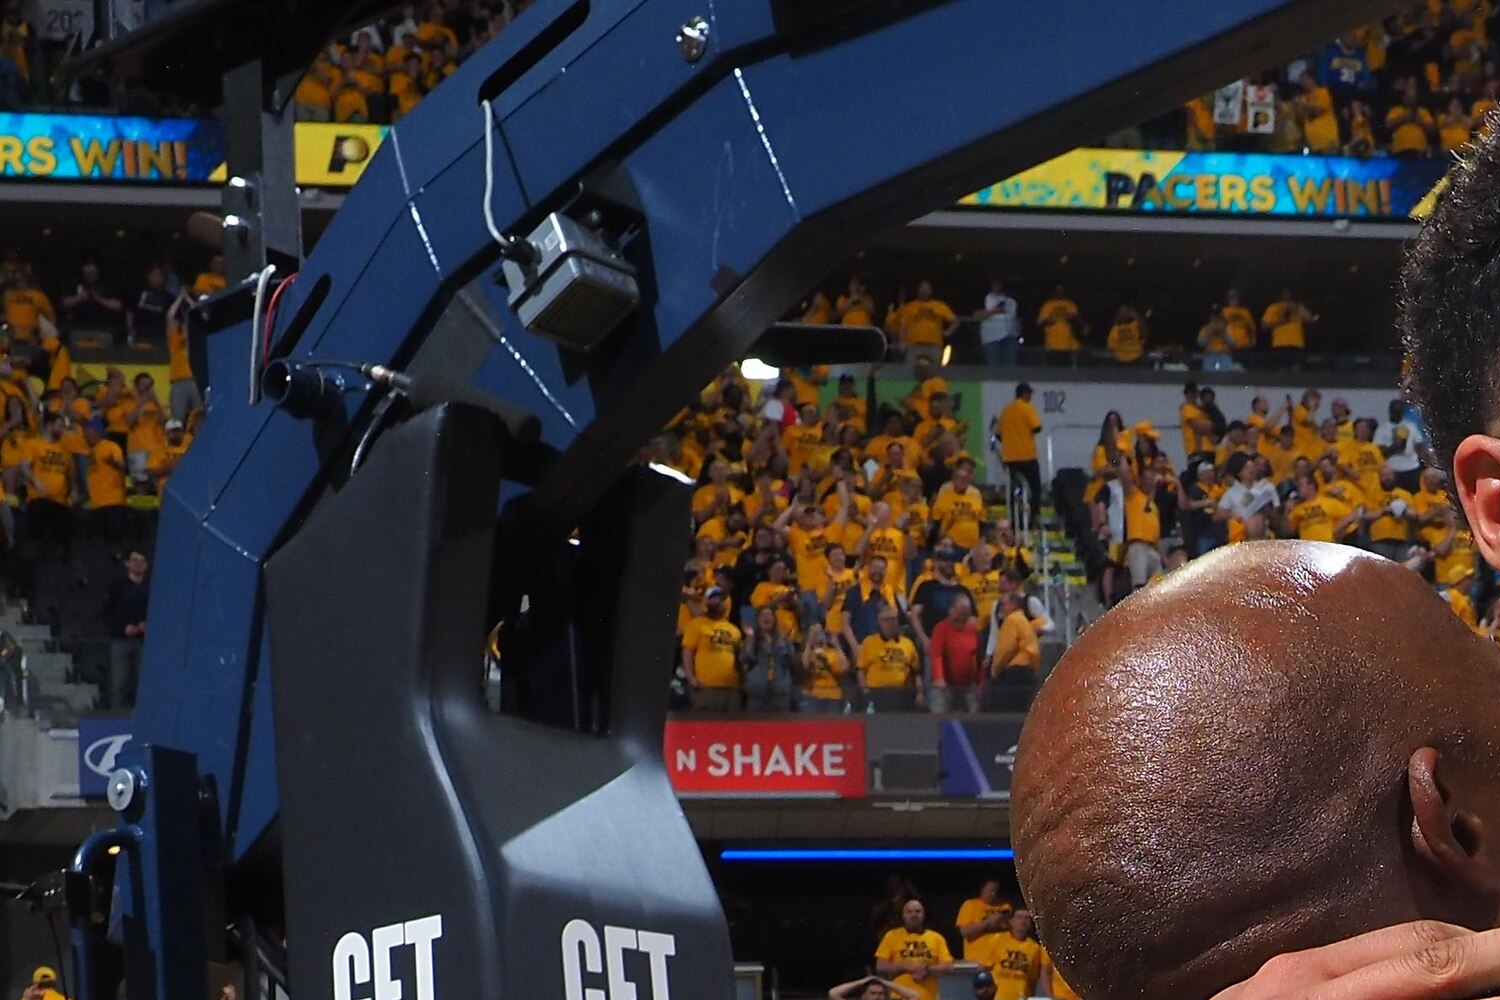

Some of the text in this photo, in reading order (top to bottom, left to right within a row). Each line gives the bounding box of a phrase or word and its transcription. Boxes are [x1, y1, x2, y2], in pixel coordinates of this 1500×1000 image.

[70, 137, 187, 179] WIN!
[1105, 172, 1392, 214] PACERS WIN!
[676, 743, 846, 777] N SHAKE
